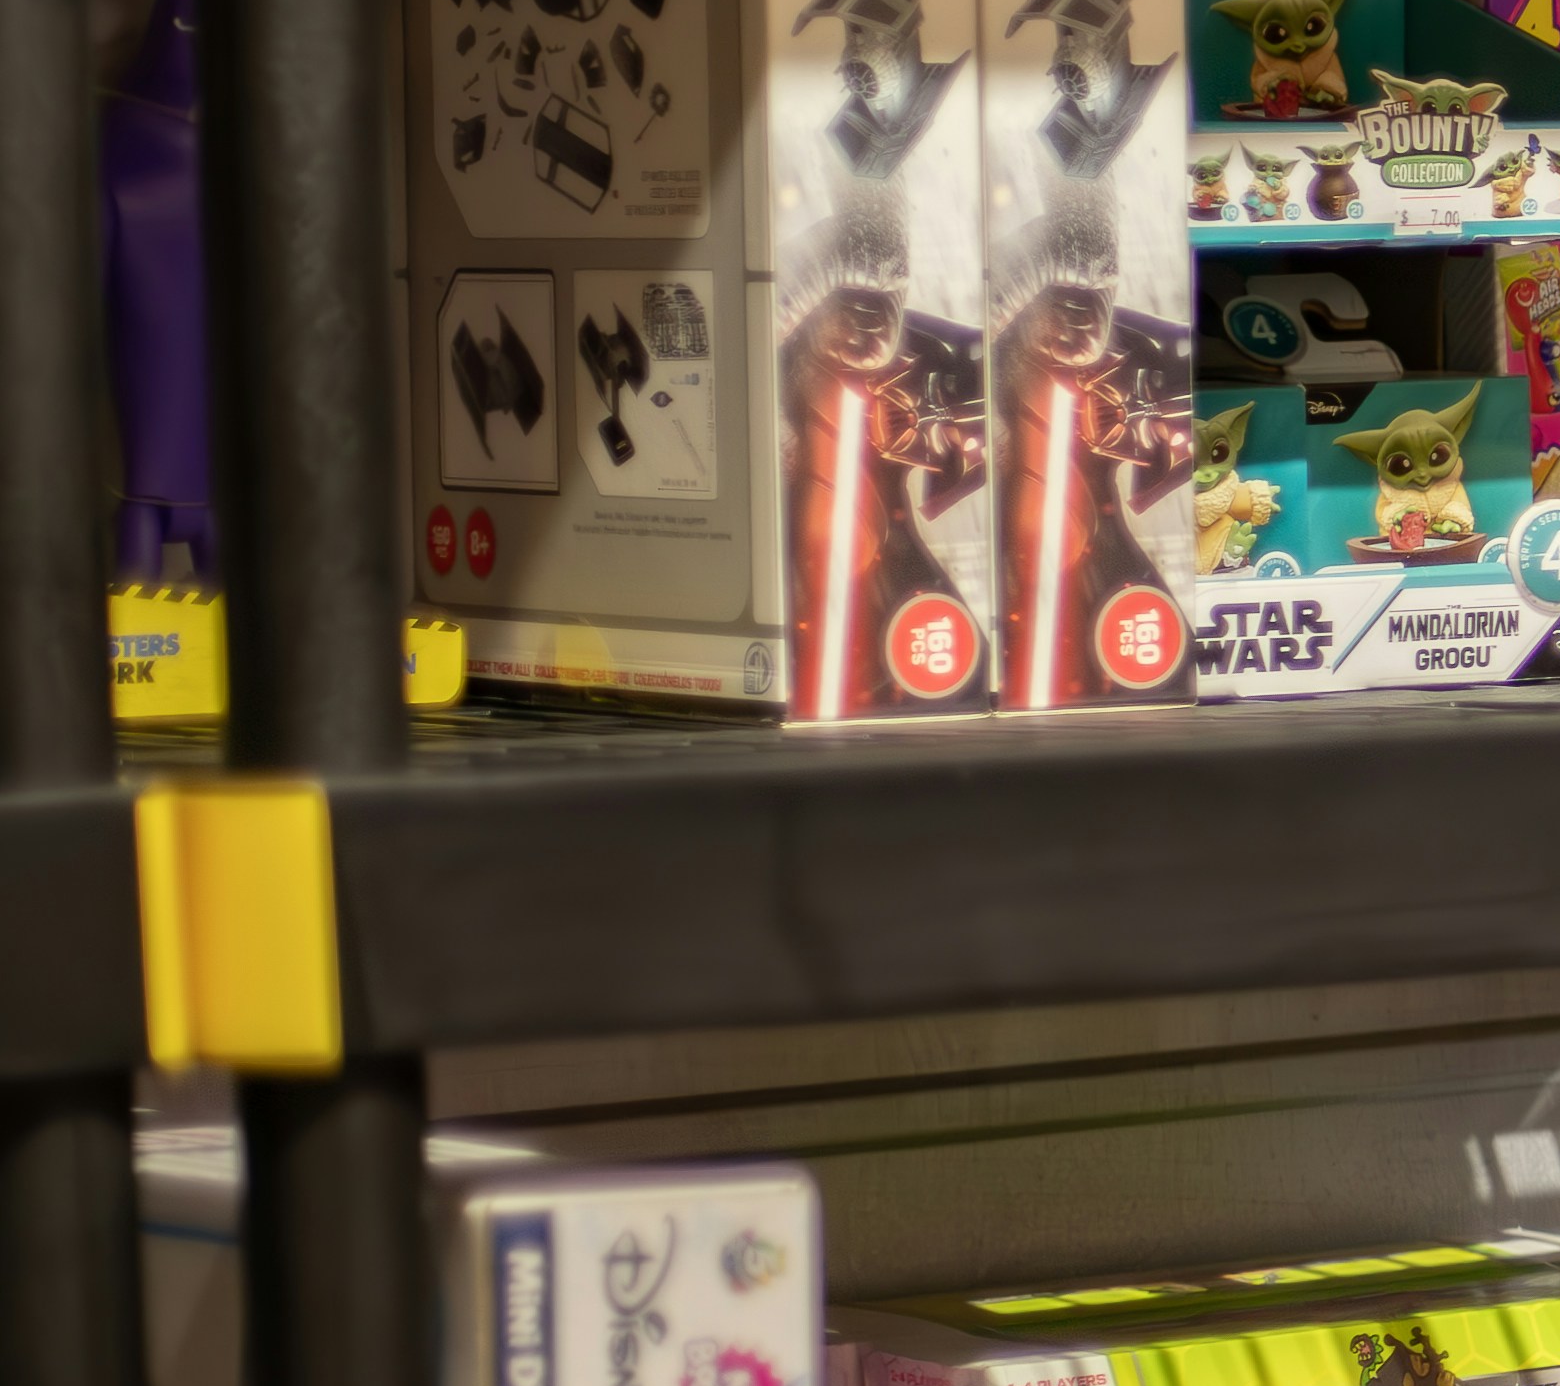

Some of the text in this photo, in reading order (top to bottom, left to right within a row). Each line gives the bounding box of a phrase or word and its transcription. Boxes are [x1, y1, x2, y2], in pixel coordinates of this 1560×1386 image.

[1384, 101, 1410, 115] THE
[1366, 112, 1493, 158] BOUNTY
[1390, 160, 1464, 185] COLLECTION
[1539, 276, 1560, 295] AIR
[1250, 312, 1279, 346] 4
[1117, 618, 1135, 658] PCS
[1134, 608, 1159, 667] 160
[1195, 599, 1333, 639] STAR
[1388, 609, 1520, 643] MANDALORIAN
[909, 627, 927, 665] PCS
[926, 617, 952, 675] 160
[1195, 634, 1333, 676] WARS
[1415, 645, 1490, 671] GROGU
[508, 1248, 543, 1345] MINI
